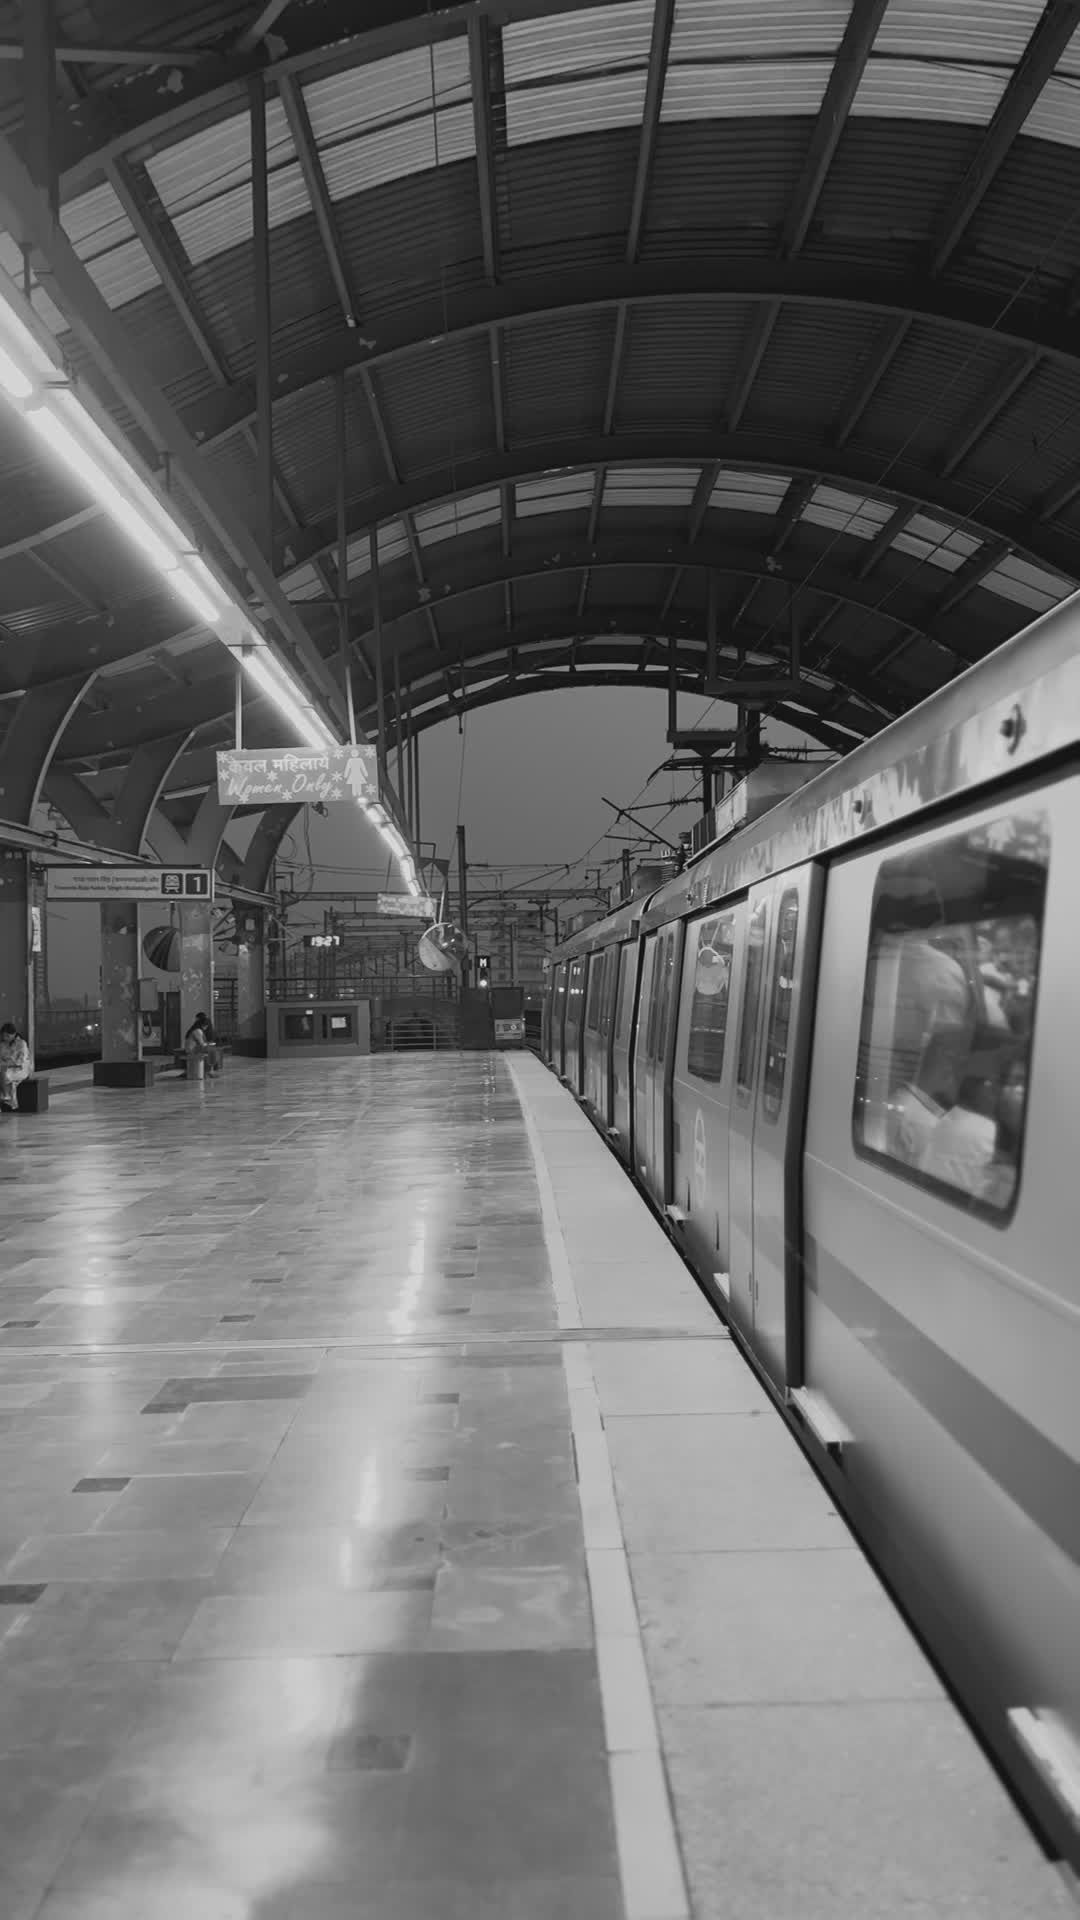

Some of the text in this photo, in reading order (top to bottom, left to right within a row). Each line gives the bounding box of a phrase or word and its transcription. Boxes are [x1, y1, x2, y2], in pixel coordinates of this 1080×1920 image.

[228, 756, 267, 774] केवल
[227, 773, 333, 799] Women Only
[193, 876, 201, 892] 1
